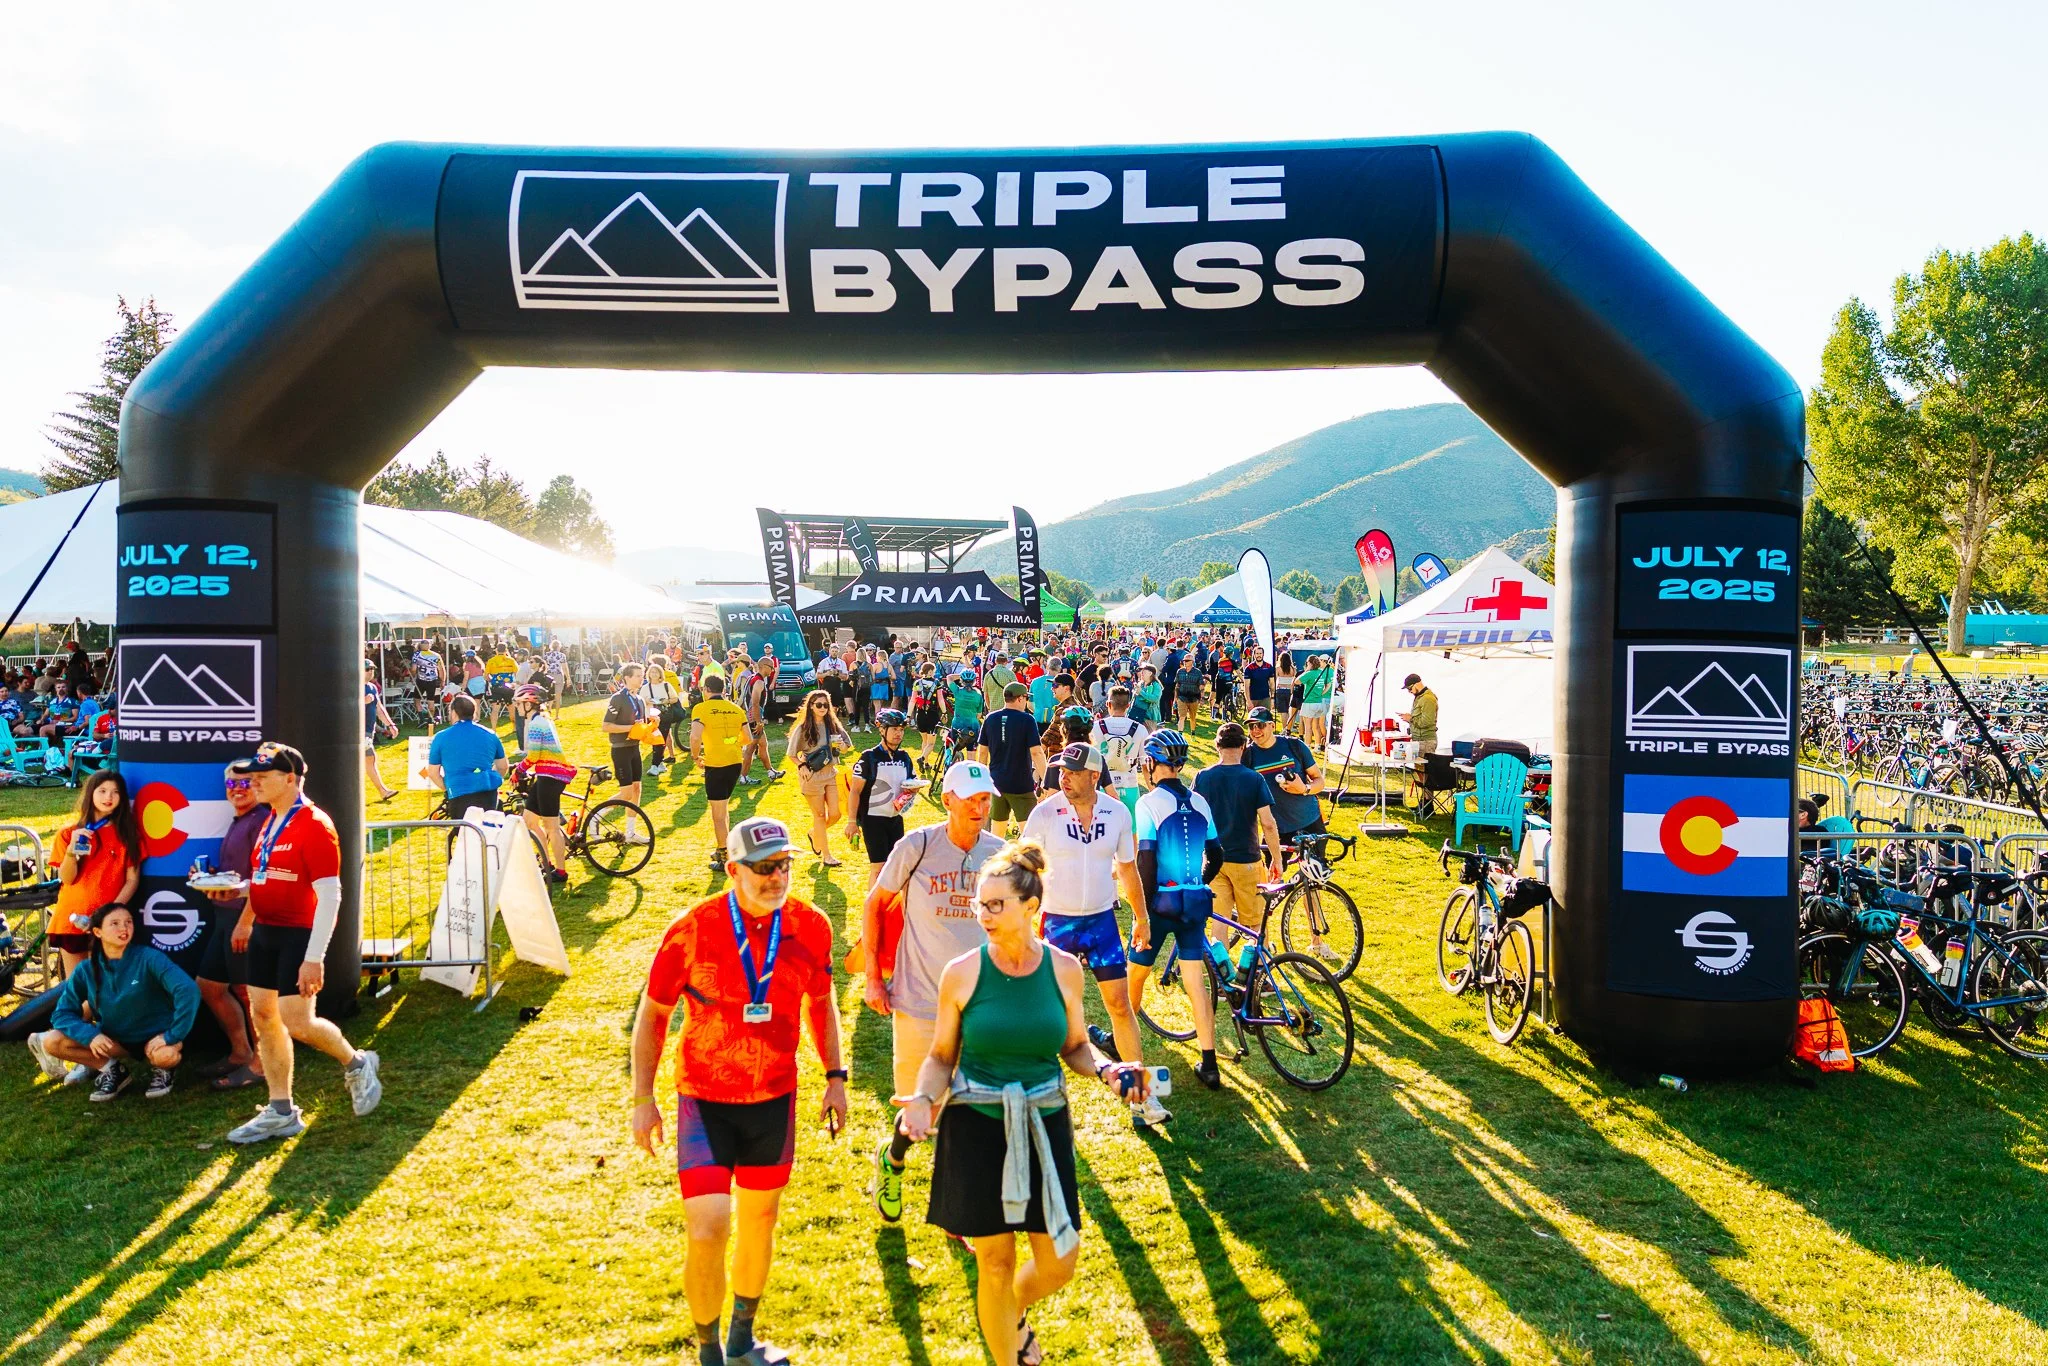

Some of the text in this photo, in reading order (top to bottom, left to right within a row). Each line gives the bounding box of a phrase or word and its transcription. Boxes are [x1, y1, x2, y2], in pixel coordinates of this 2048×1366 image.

[809, 165, 1286, 228] TRIPLE
[809, 237, 1366, 313] BYPASS
[120, 544, 258, 570] JULY 12,
[766, 527, 791, 602] PRIMAL
[1368, 540, 1383, 567] tailwind
[1632, 546, 1791, 576] JULY 12,
[1019, 526, 1036, 606] PRIMAL
[128, 574, 230, 597] 2025
[850, 583, 991, 604] PRIMAL
[1658, 578, 1776, 603] 2025
[727, 612, 792, 622] PRIMAL
[799, 614, 841, 624] PRIMAL
[996, 614, 1038, 624] PRIMAL
[1397, 629, 1554, 649] MEDICA
[118, 729, 262, 742] TRIPLE BYPASS
[1625, 740, 1790, 756] TRIPLE BYPASS
[1066, 822, 1105, 845] USA
[1183, 815, 1191, 877] AMBASSADOR
[928, 870, 958, 895] KEY
[449, 907, 477, 922] OUTSIDE
[1283, 887, 1306, 954] REYNOLDS
[151, 928, 202, 952] SHIFT EVENTS
[1694, 952, 1751, 976] SHIFT EVENTS
